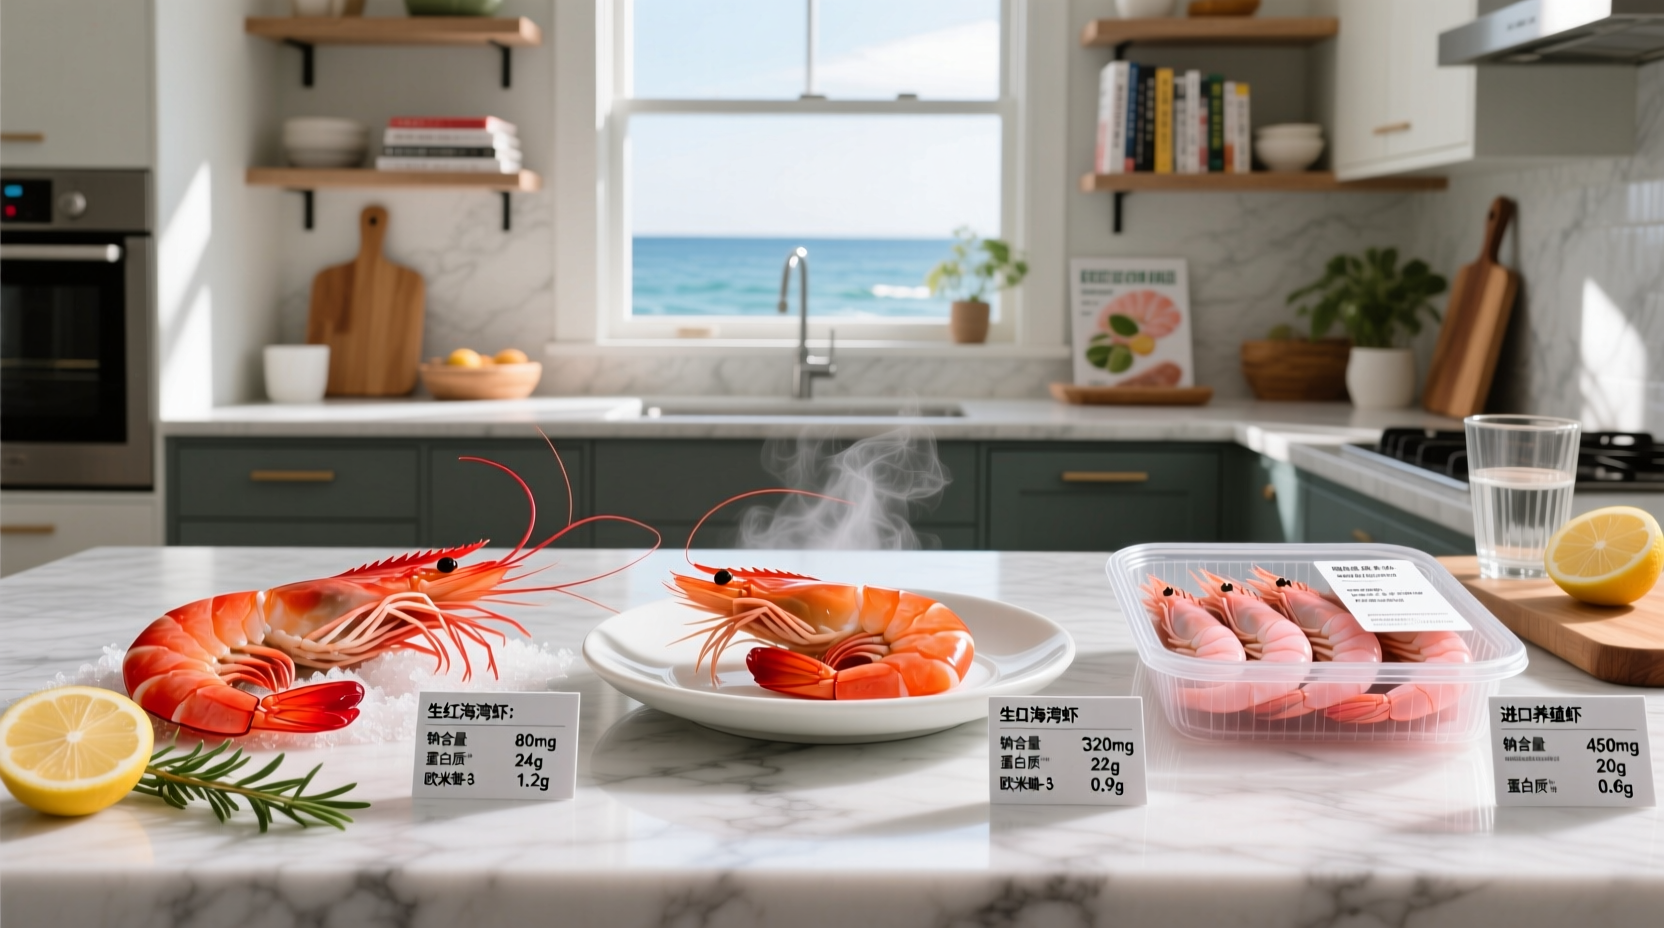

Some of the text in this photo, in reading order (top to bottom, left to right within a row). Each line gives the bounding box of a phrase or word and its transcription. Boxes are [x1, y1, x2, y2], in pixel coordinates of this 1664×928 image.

[1500, 705, 1582, 724] 进口养殖虾
[514, 733, 557, 751] 80mg
[1082, 736, 1134, 756] 320mg
[1586, 737, 1640, 757] 450mg
[514, 753, 543, 771] 24g
[1090, 757, 1120, 776] 22g
[1596, 758, 1626, 777] 20g
[517, 773, 550, 791] 1.2g
[1090, 777, 1124, 796] 0.9g
[1598, 778, 1634, 799] 0.6g
